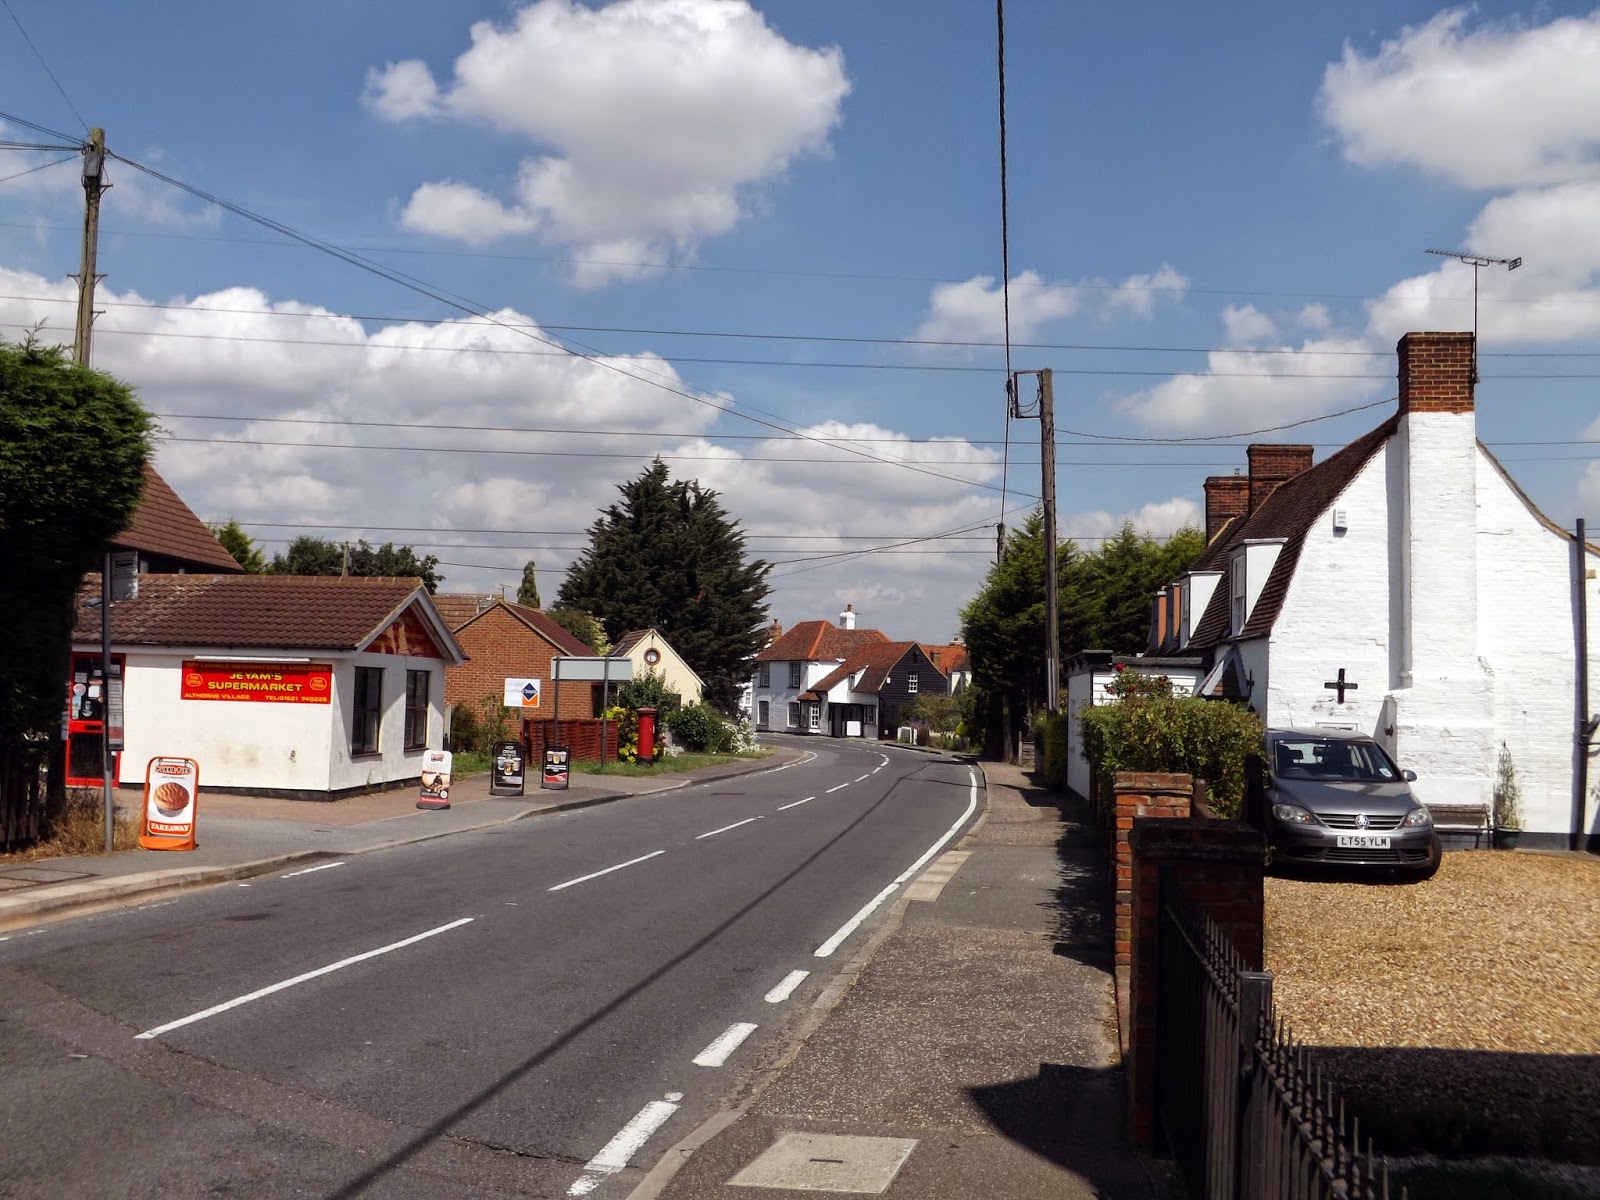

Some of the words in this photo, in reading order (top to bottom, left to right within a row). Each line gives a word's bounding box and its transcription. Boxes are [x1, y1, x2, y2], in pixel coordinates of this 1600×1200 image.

[229, 672, 282, 681] JEYAM'S
[208, 681, 303, 692] SUPERMARKET
[151, 822, 190, 832] TAKEAWAY
[1341, 836, 1367, 846] LT55
[1369, 837, 1387, 847] YLM
